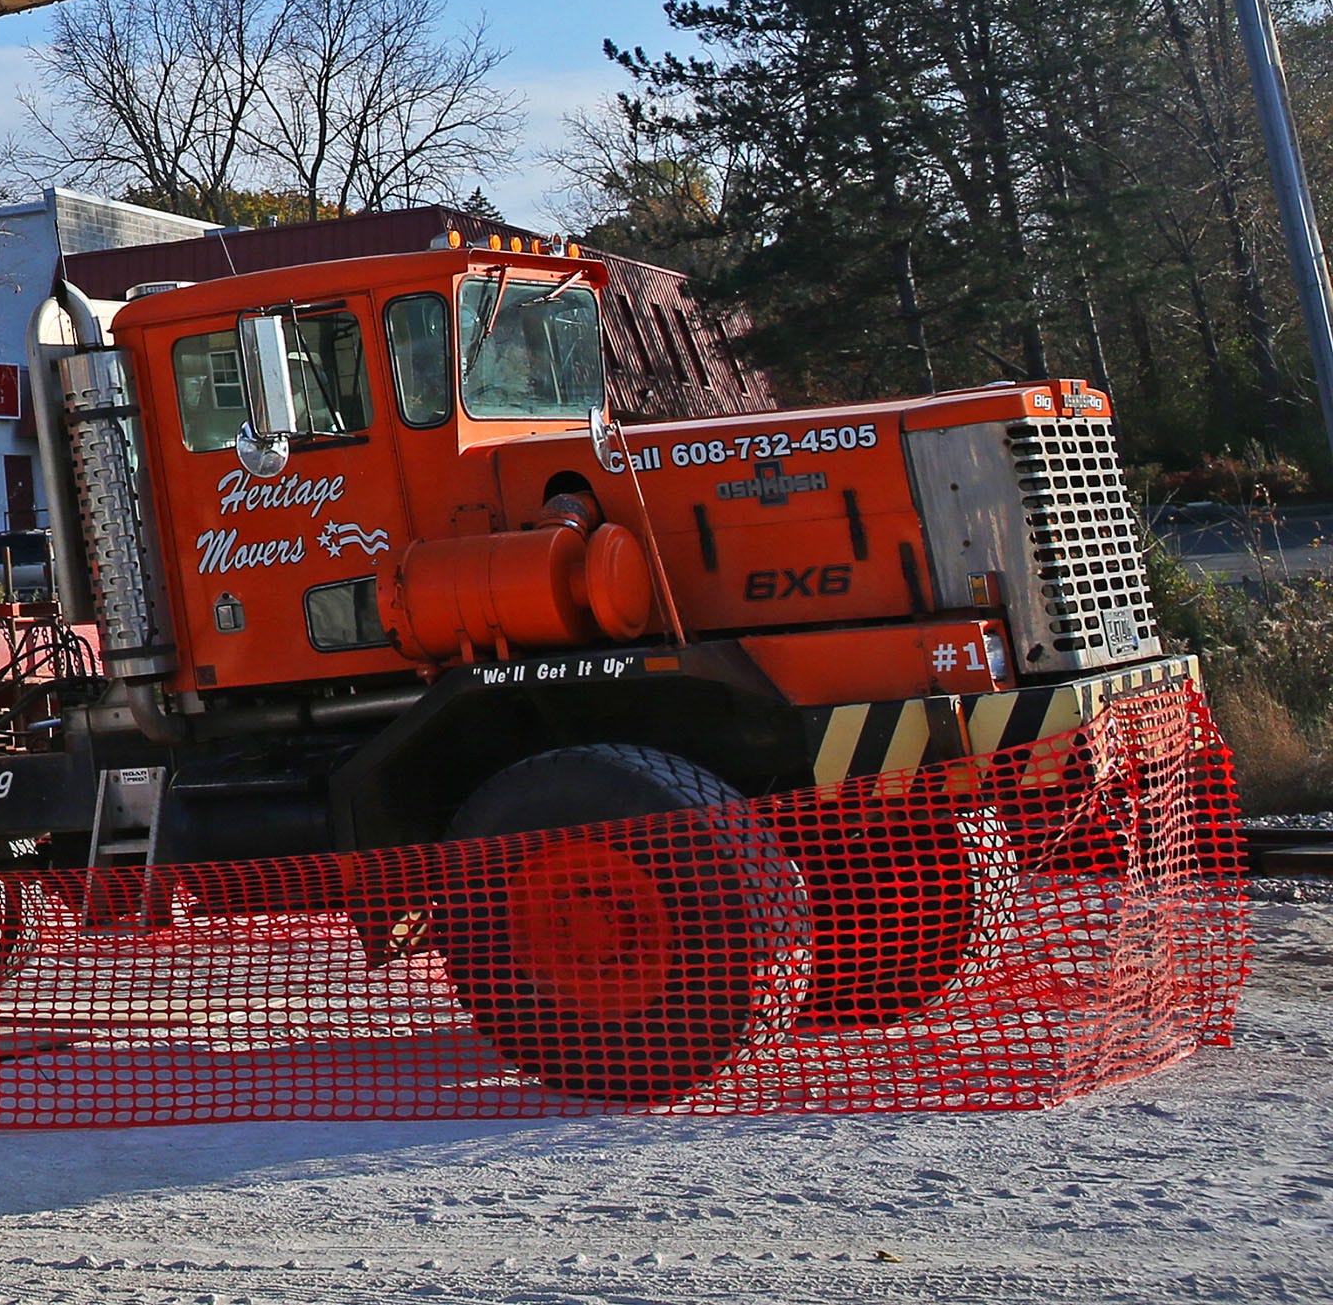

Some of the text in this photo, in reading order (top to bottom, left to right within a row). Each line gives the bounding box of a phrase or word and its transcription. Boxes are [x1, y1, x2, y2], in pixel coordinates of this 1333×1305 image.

[1034, 394, 1052, 410] Big
[609, 424, 877, 474] Call 608-732-4505
[217, 469, 345, 518] Heritage
[196, 528, 305, 575] Movers
[537, 663, 567, 680] Get
[578, 660, 593, 676] It
[932, 642, 985, 672] #1
